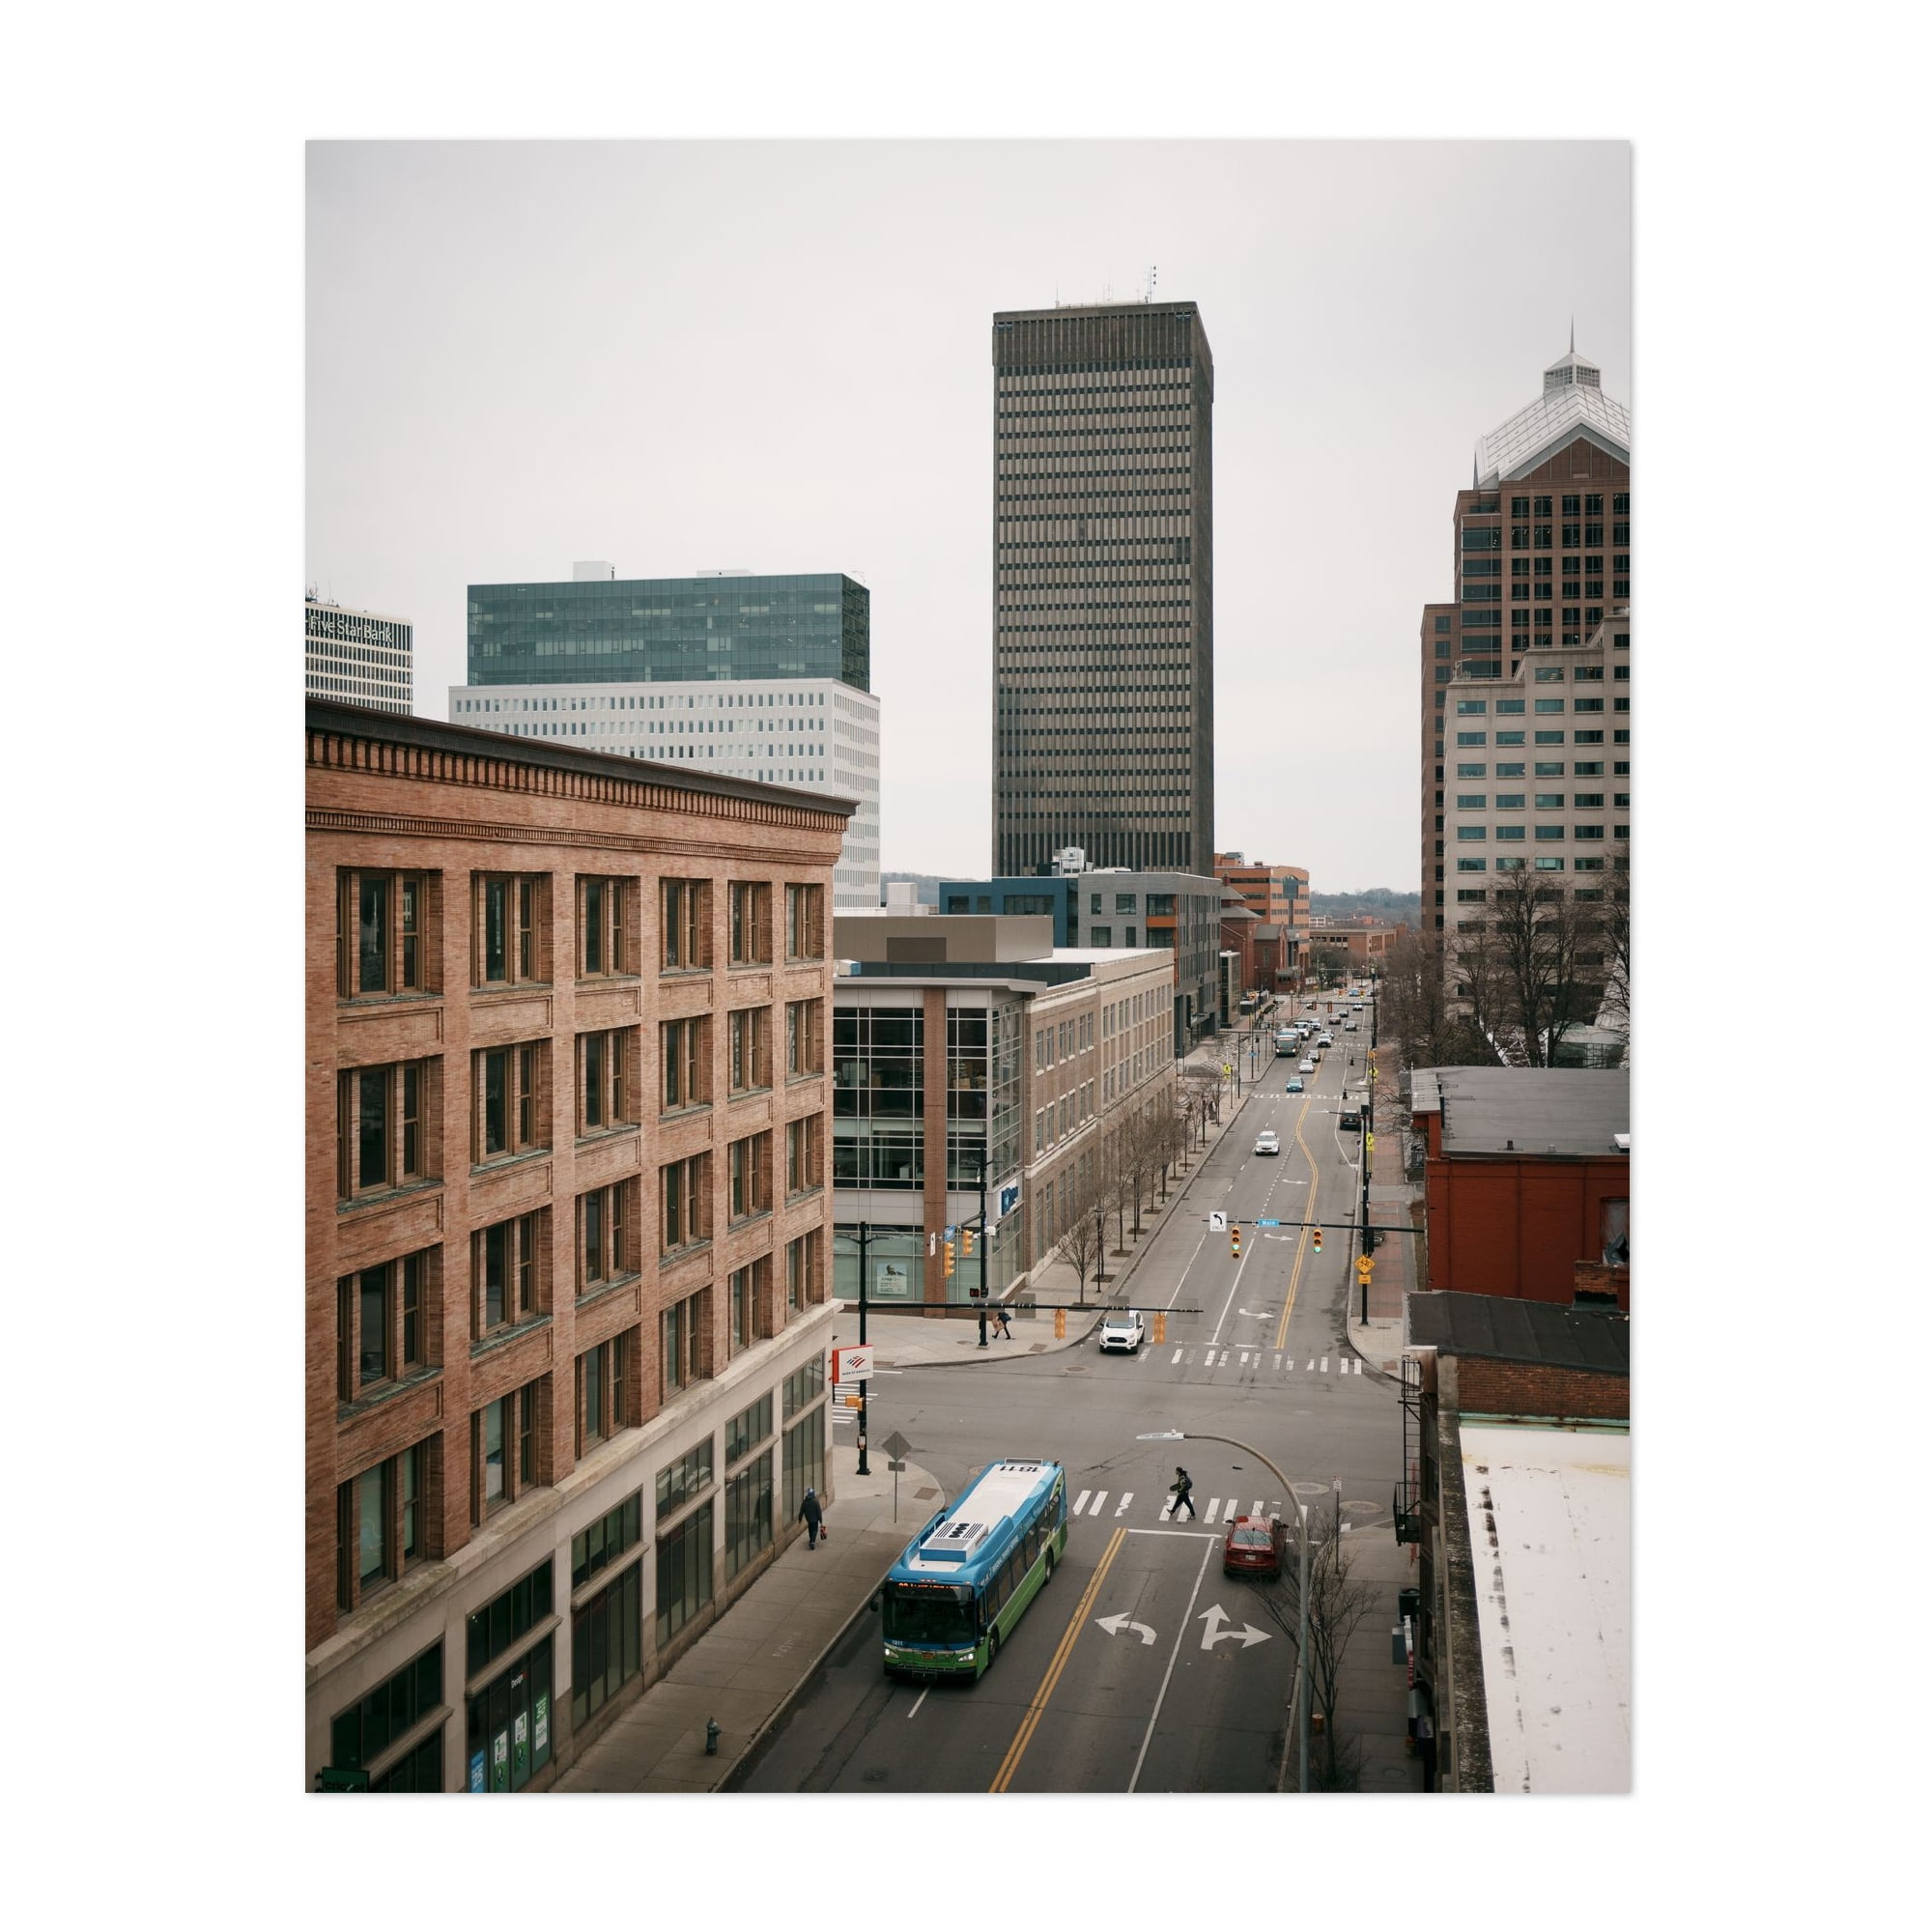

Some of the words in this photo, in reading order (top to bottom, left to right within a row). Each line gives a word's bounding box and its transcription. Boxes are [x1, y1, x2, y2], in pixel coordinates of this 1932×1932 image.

[310, 616, 335, 634] Five
[337, 620, 362, 638] Star
[363, 625, 392, 642] Bank
